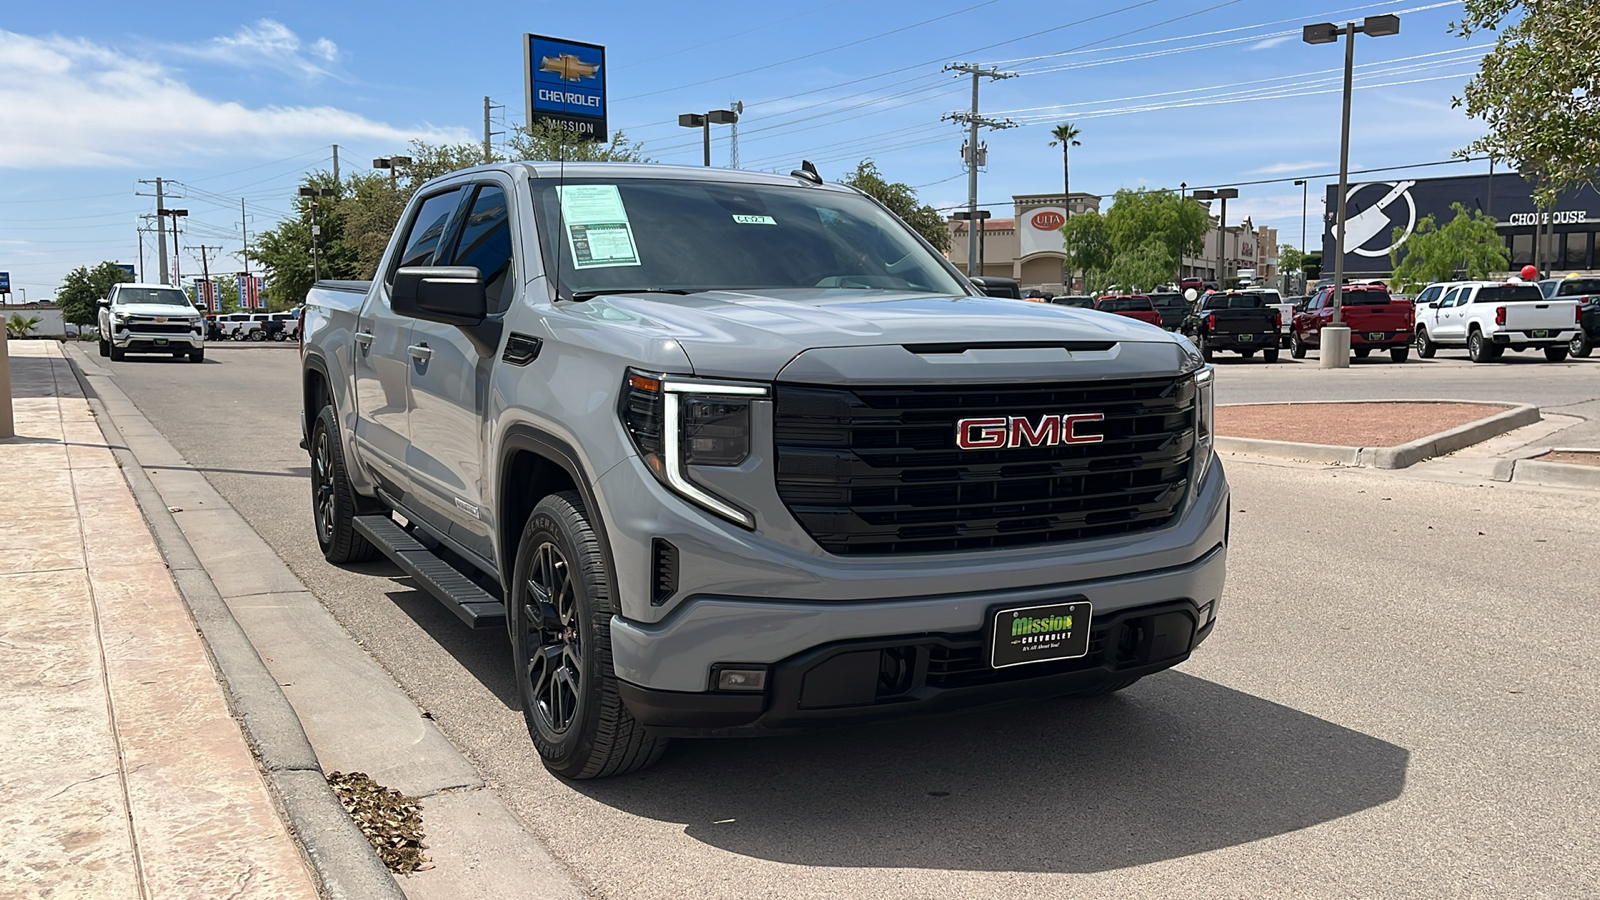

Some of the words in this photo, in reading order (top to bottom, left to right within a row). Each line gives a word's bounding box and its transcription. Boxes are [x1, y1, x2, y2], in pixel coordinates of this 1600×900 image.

[538, 89, 601, 107] CHEVROLET
[1037, 215, 1060, 224] ULTA
[956, 413, 1104, 449] GMC
[526, 517, 560, 541] GENERAL
[1012, 614, 1073, 636] Mission
[1021, 632, 1072, 644] CHEVROLET
